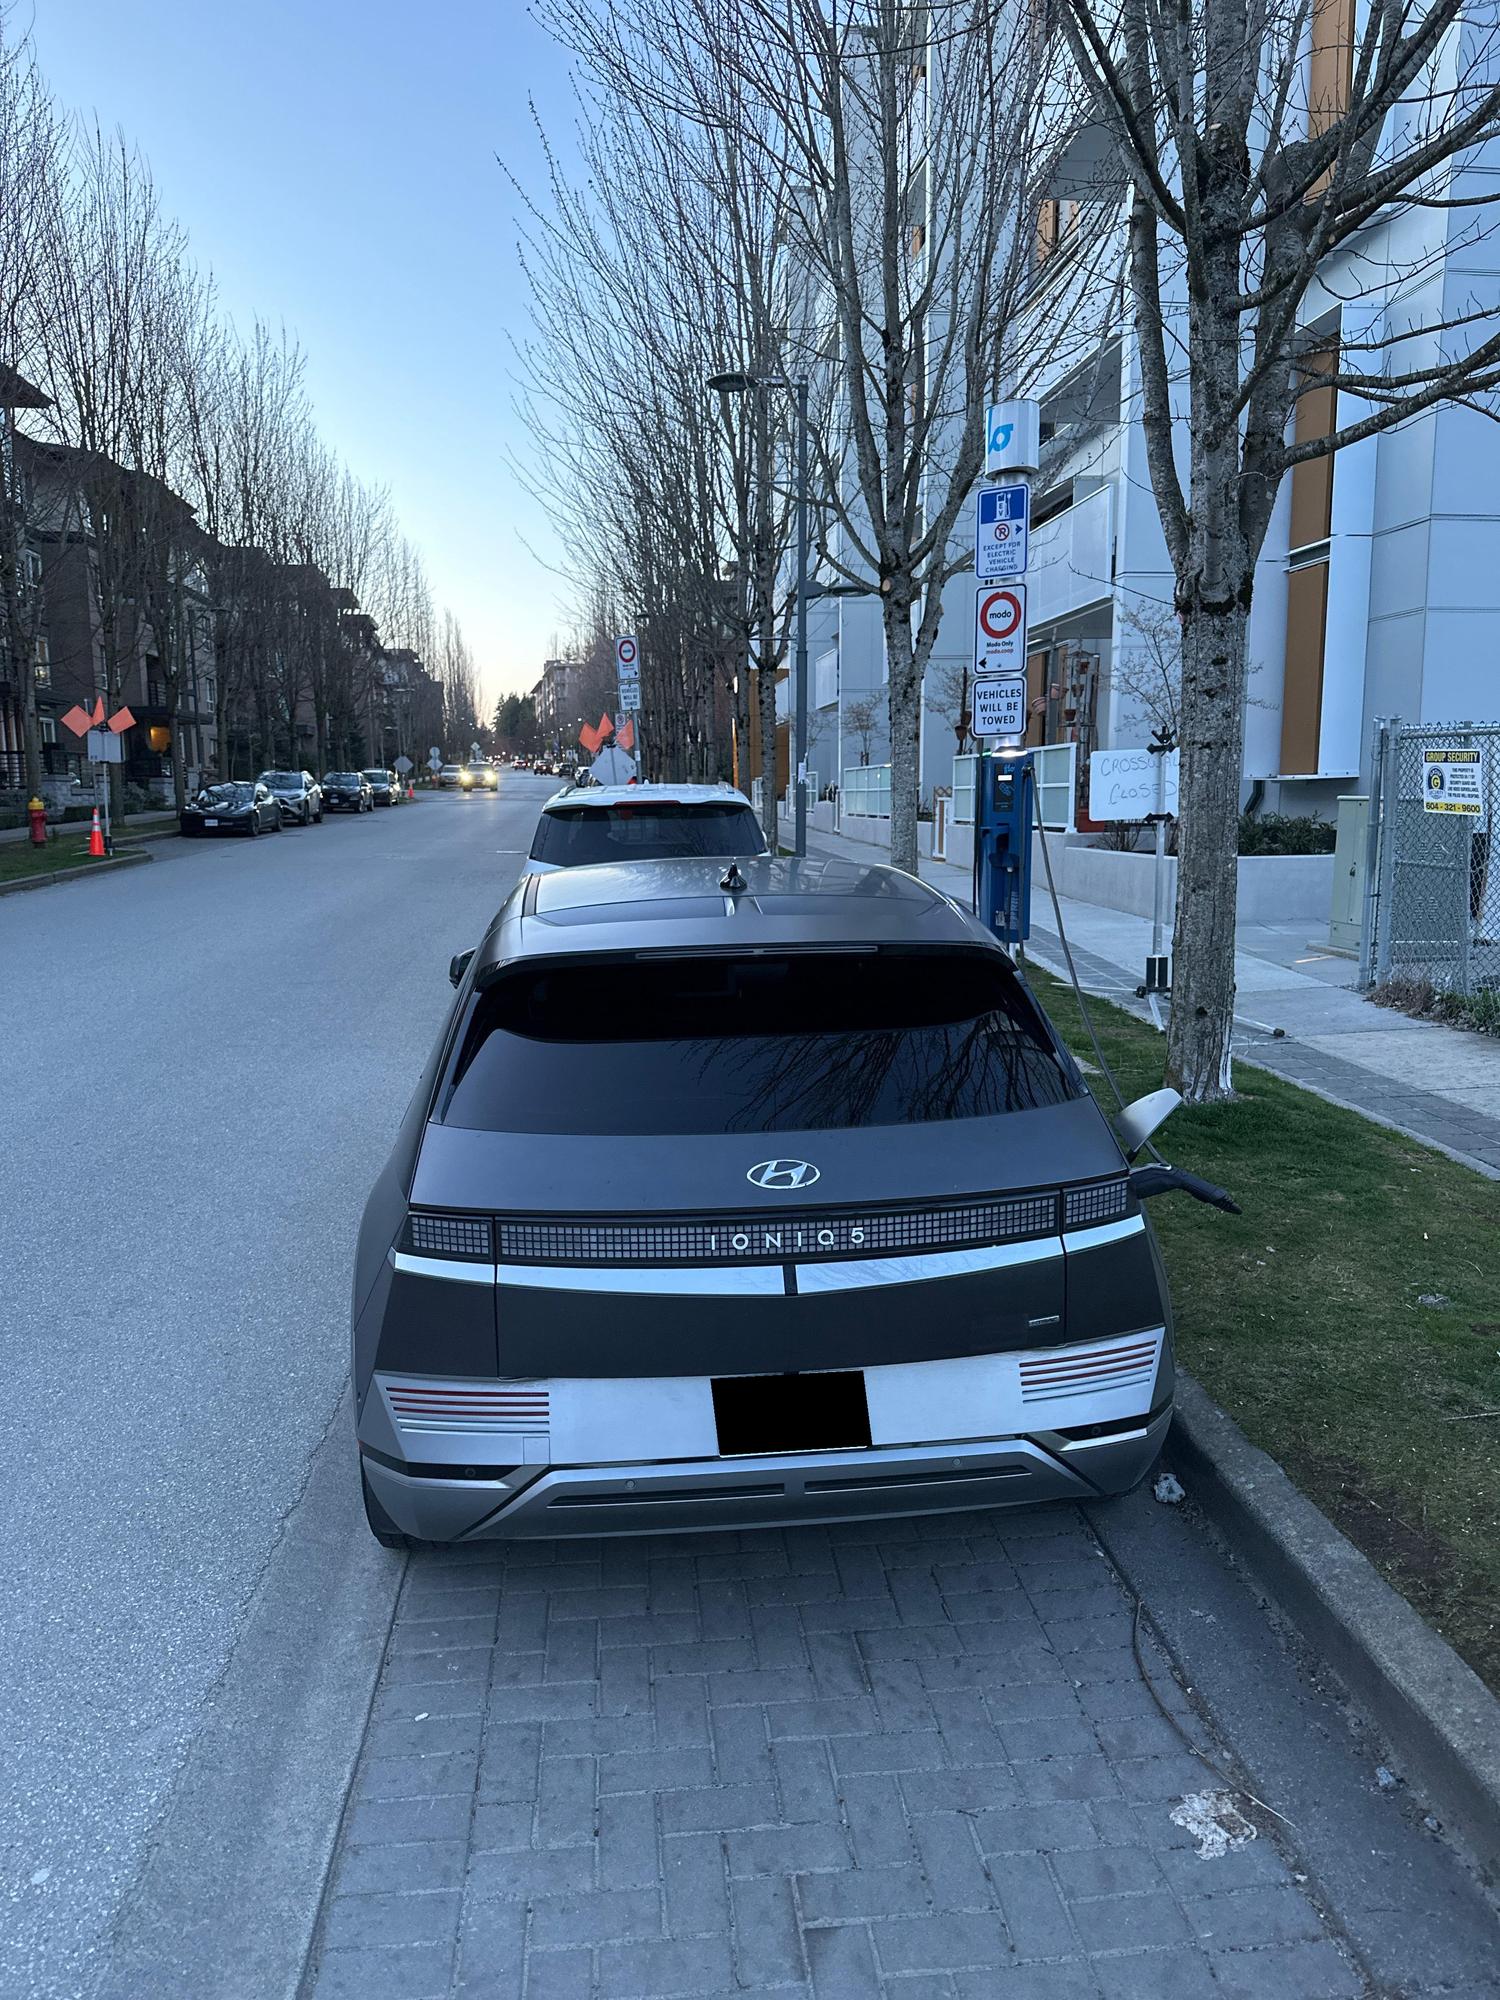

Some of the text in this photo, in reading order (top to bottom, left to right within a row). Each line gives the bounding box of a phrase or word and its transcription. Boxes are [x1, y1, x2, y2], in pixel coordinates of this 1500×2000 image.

[983, 543, 1007, 551] EXCEPT
[987, 550, 1016, 558] ELECTRIC
[988, 557, 1015, 565] VEHICLE
[985, 565, 1018, 573] CHARGING
[989, 610, 1012, 619] modo
[977, 688, 1022, 700] VEHICLES
[980, 702, 1019, 712] WILL BE
[982, 715, 1016, 725] TOWED
[1426, 752, 1478, 762] GROUP SECURITY
[1101, 756, 1180, 776] CROSSWAL
[1109, 780, 1177, 805] CLOSED
[711, 1229, 834, 1250] IONIQ
